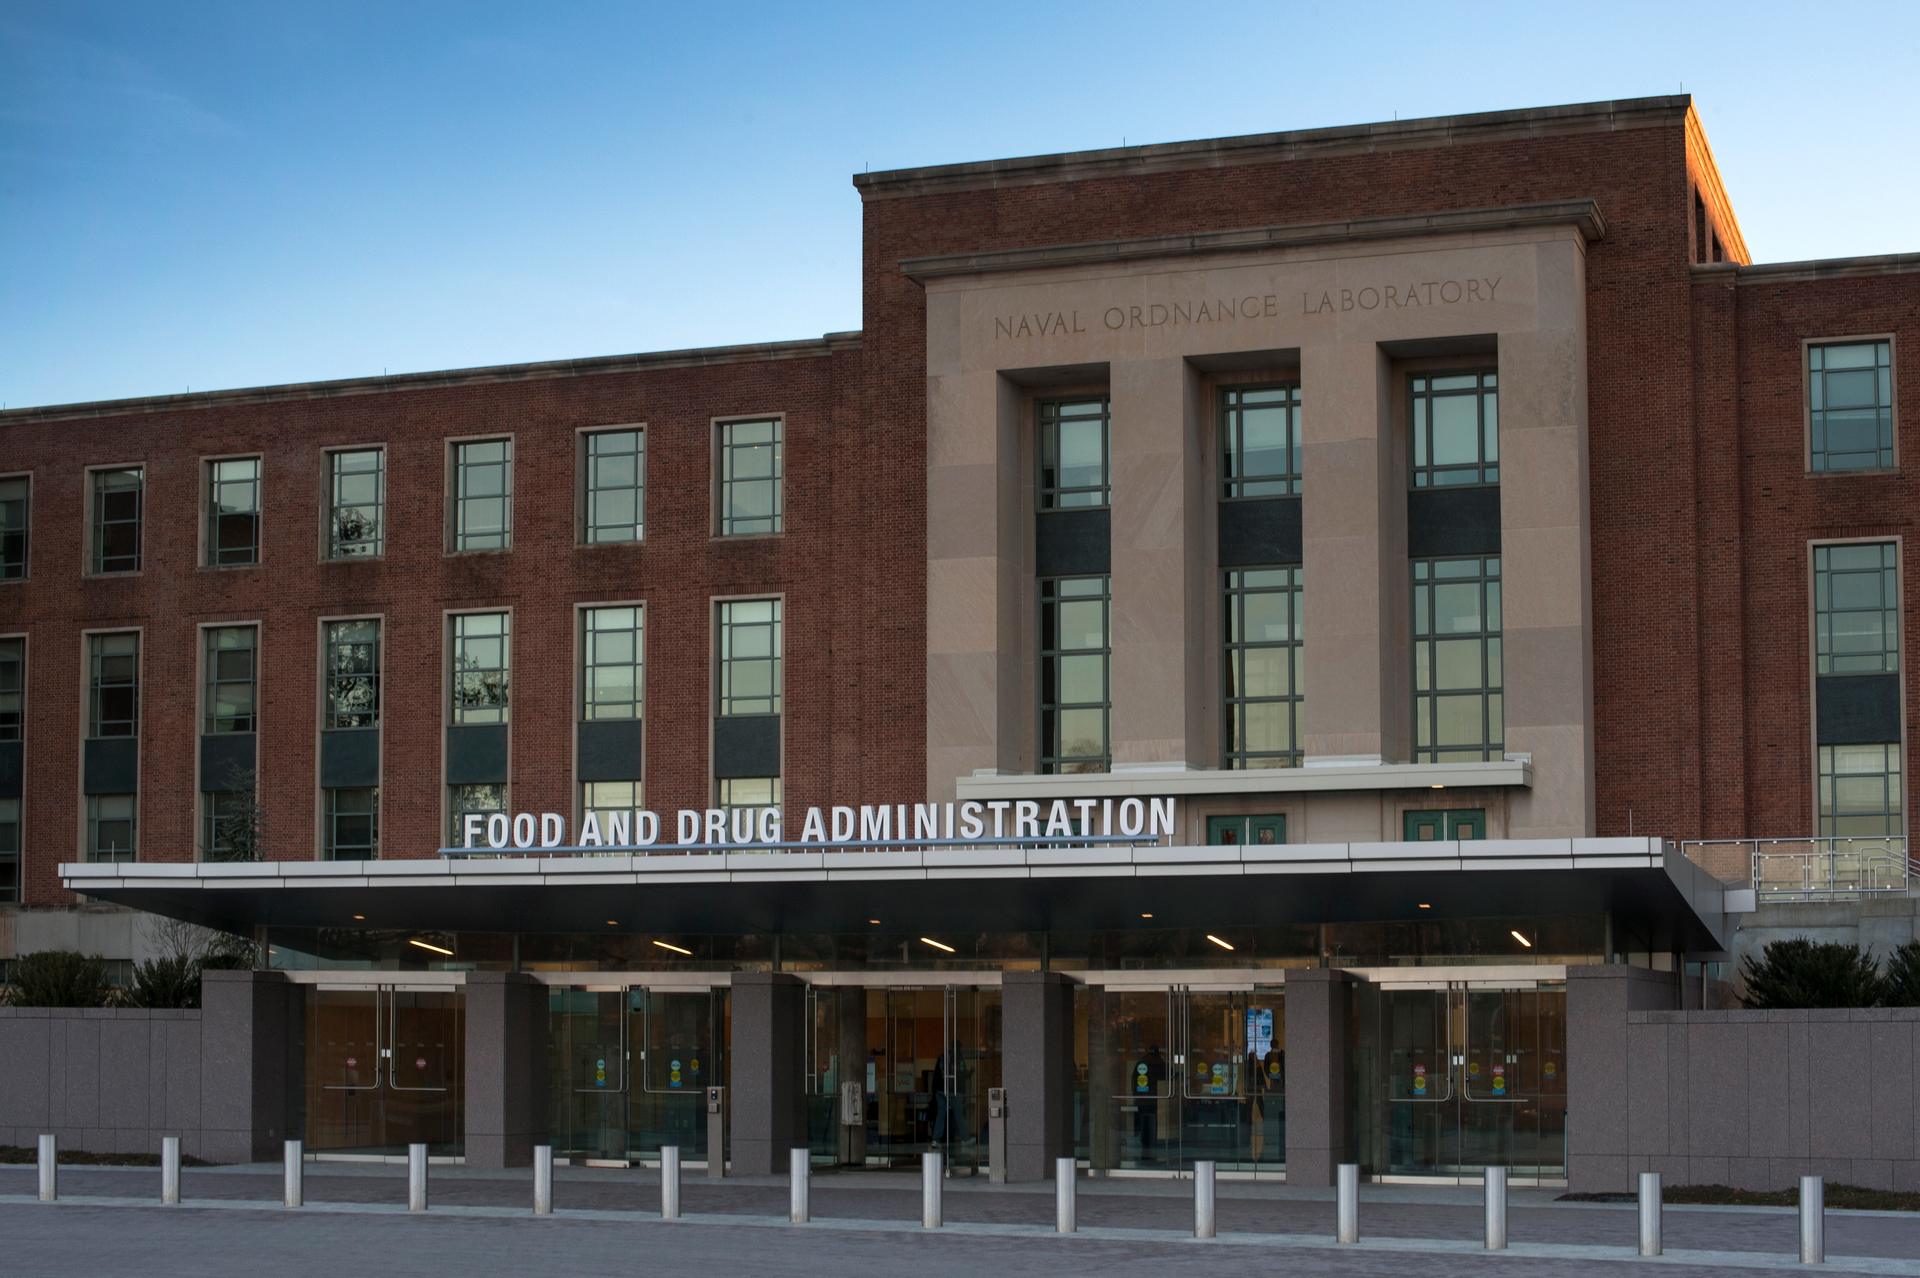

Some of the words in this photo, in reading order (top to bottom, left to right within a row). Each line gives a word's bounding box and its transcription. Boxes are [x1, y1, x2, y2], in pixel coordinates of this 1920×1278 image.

[994, 311, 1086, 339] NAVAL
[1104, 295, 1278, 330] ORDNANCE
[1302, 277, 1503, 314] LABORATORY
[463, 813, 565, 848] FOOD
[578, 811, 661, 847] AND
[677, 807, 782, 846] DRUG
[800, 797, 1176, 843] ADMINISTRATION
